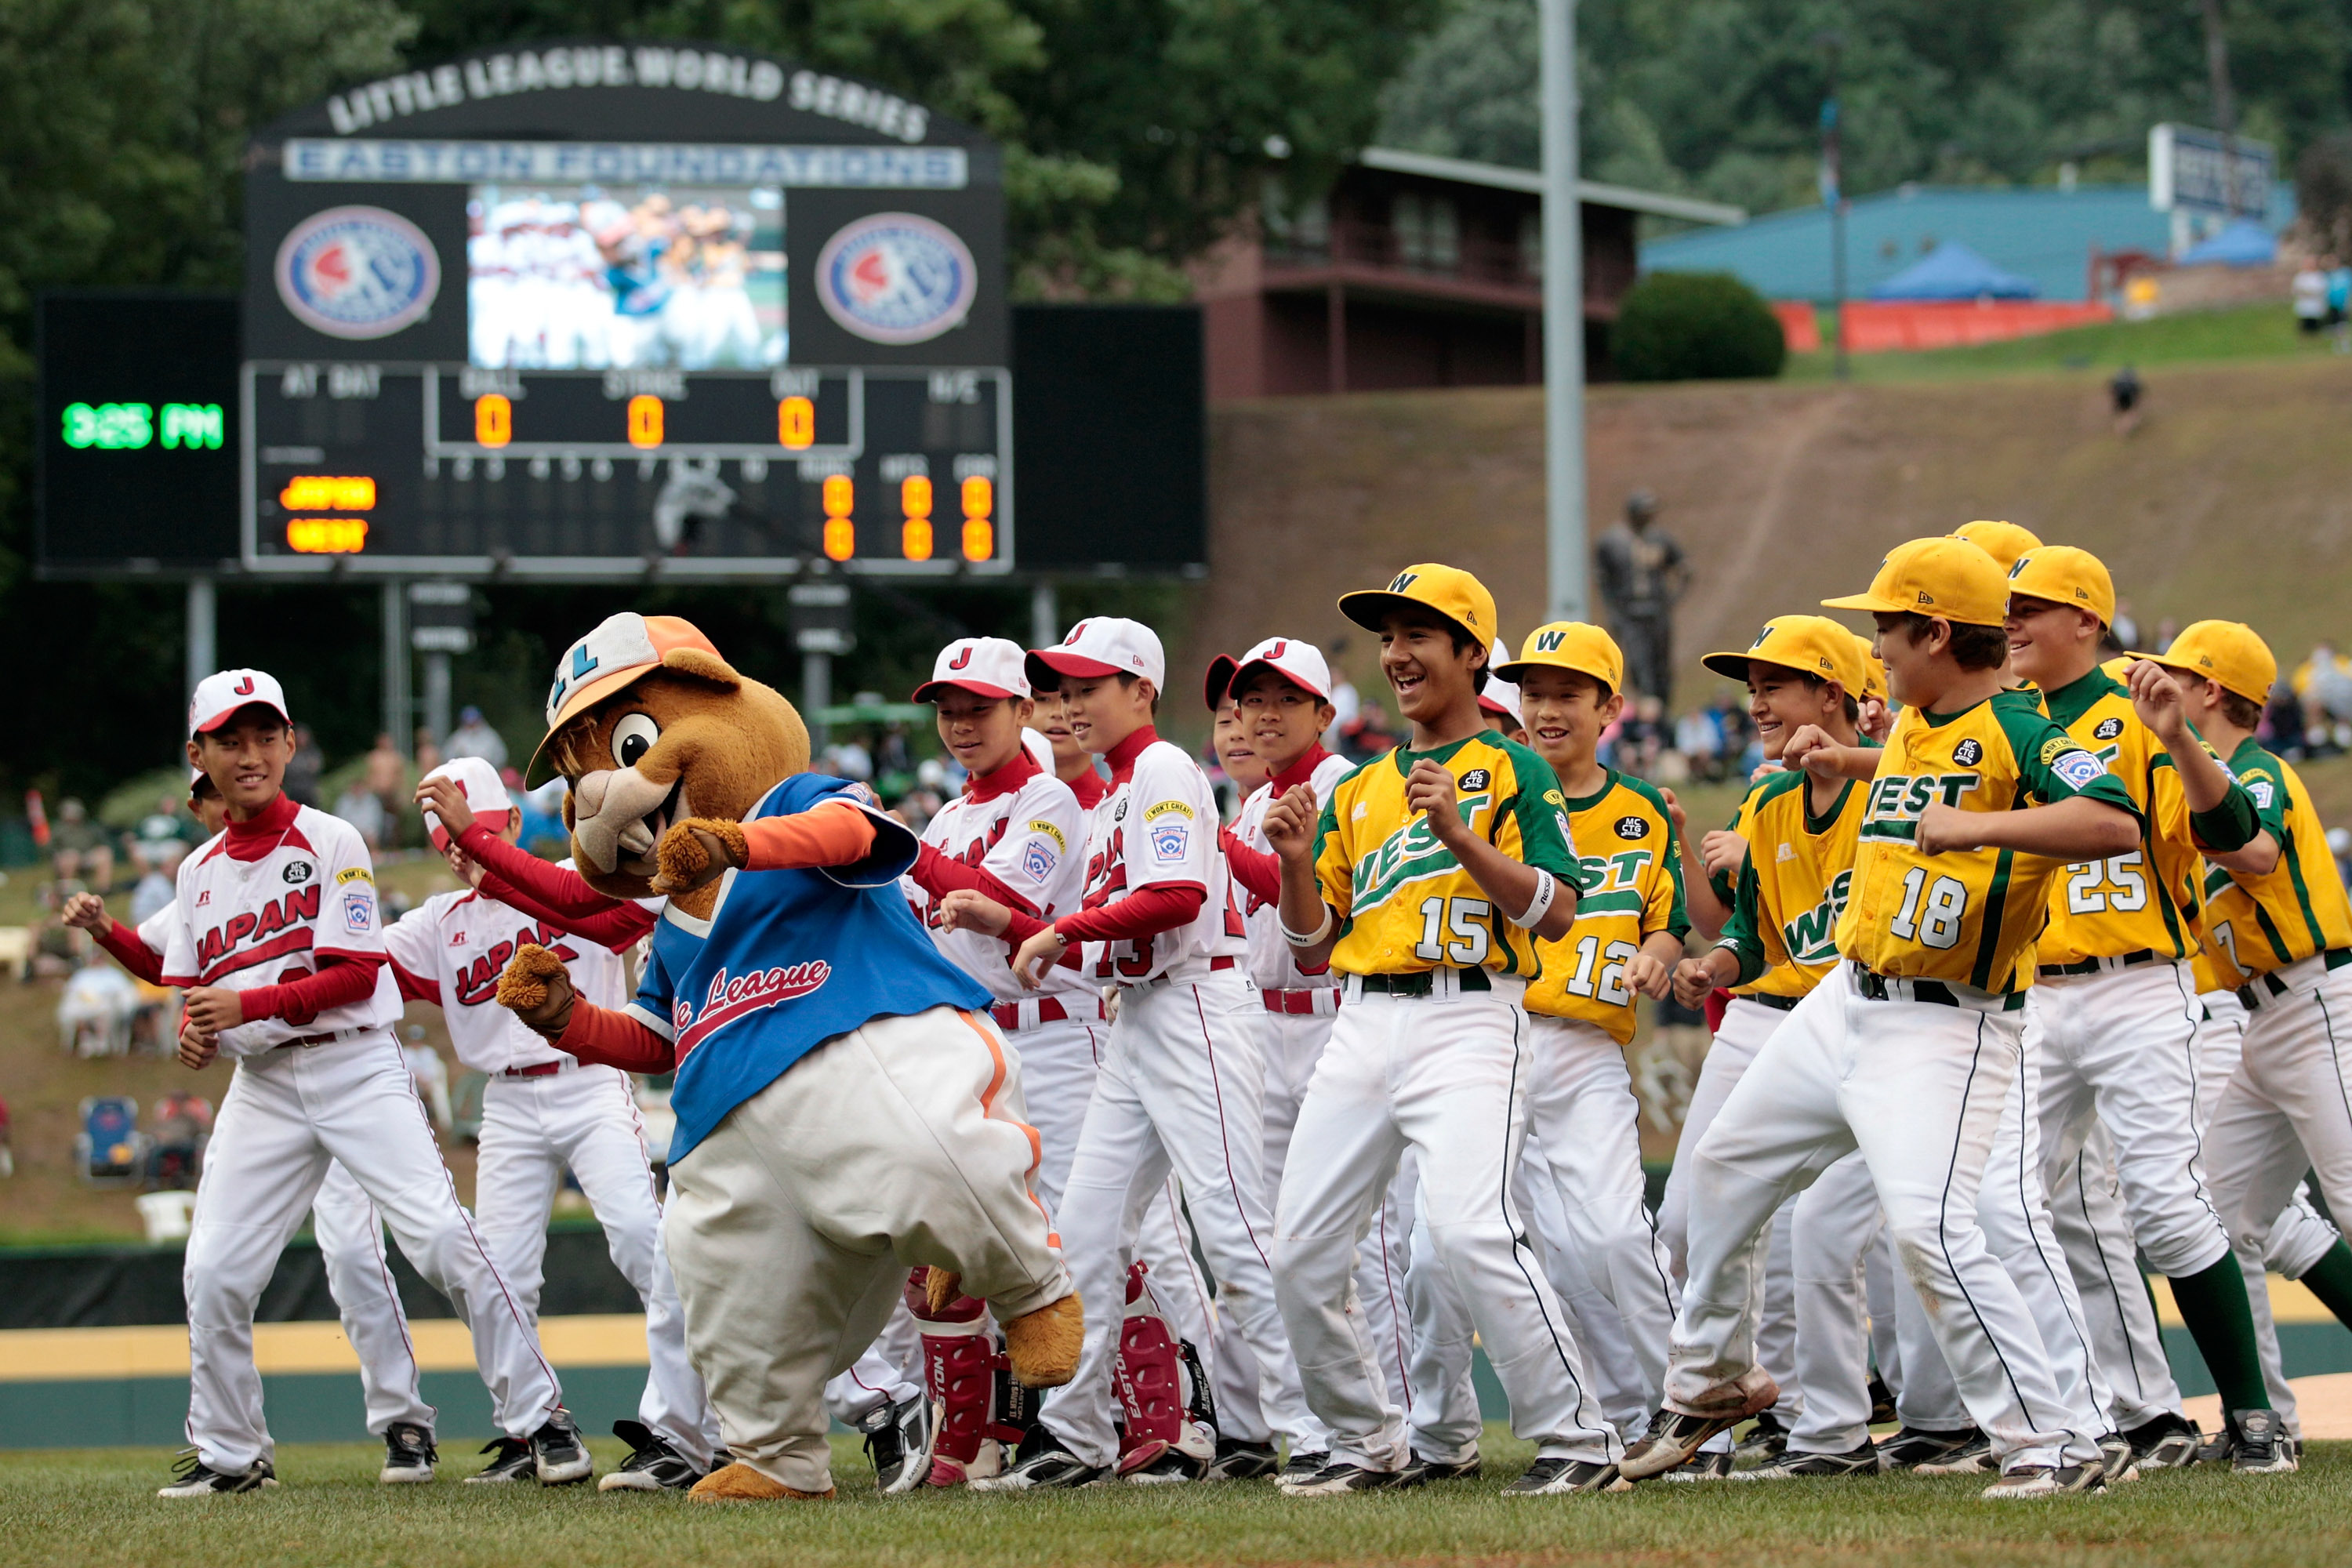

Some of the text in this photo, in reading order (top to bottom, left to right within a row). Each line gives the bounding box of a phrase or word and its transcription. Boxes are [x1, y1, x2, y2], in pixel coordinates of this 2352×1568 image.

[328, 45, 930, 144] LITTLE LEAGUE WORLD SERIES
[297, 142, 953, 183] EASTON FOUNDATIONS
[160, 403, 223, 449] PM
[1389, 573, 1418, 593] W
[1065, 624, 1087, 646] J
[1263, 641, 1287, 660] J
[1534, 631, 1566, 653] W
[949, 648, 972, 670] J
[234, 677, 255, 695] J
[1958, 748, 1975, 759] CTG
[1962, 740, 1977, 750] MC
[1151, 803, 1170, 815] WON'T
[1171, 803, 1192, 816] CHEAT!
[2067, 850, 2147, 915] 25
[1890, 866, 1969, 950] 18
[1415, 896, 1490, 964] 15
[1566, 935, 1639, 1007] 12
[699, 960, 831, 1022] League
[1116, 1352, 1142, 1419] EASTO
